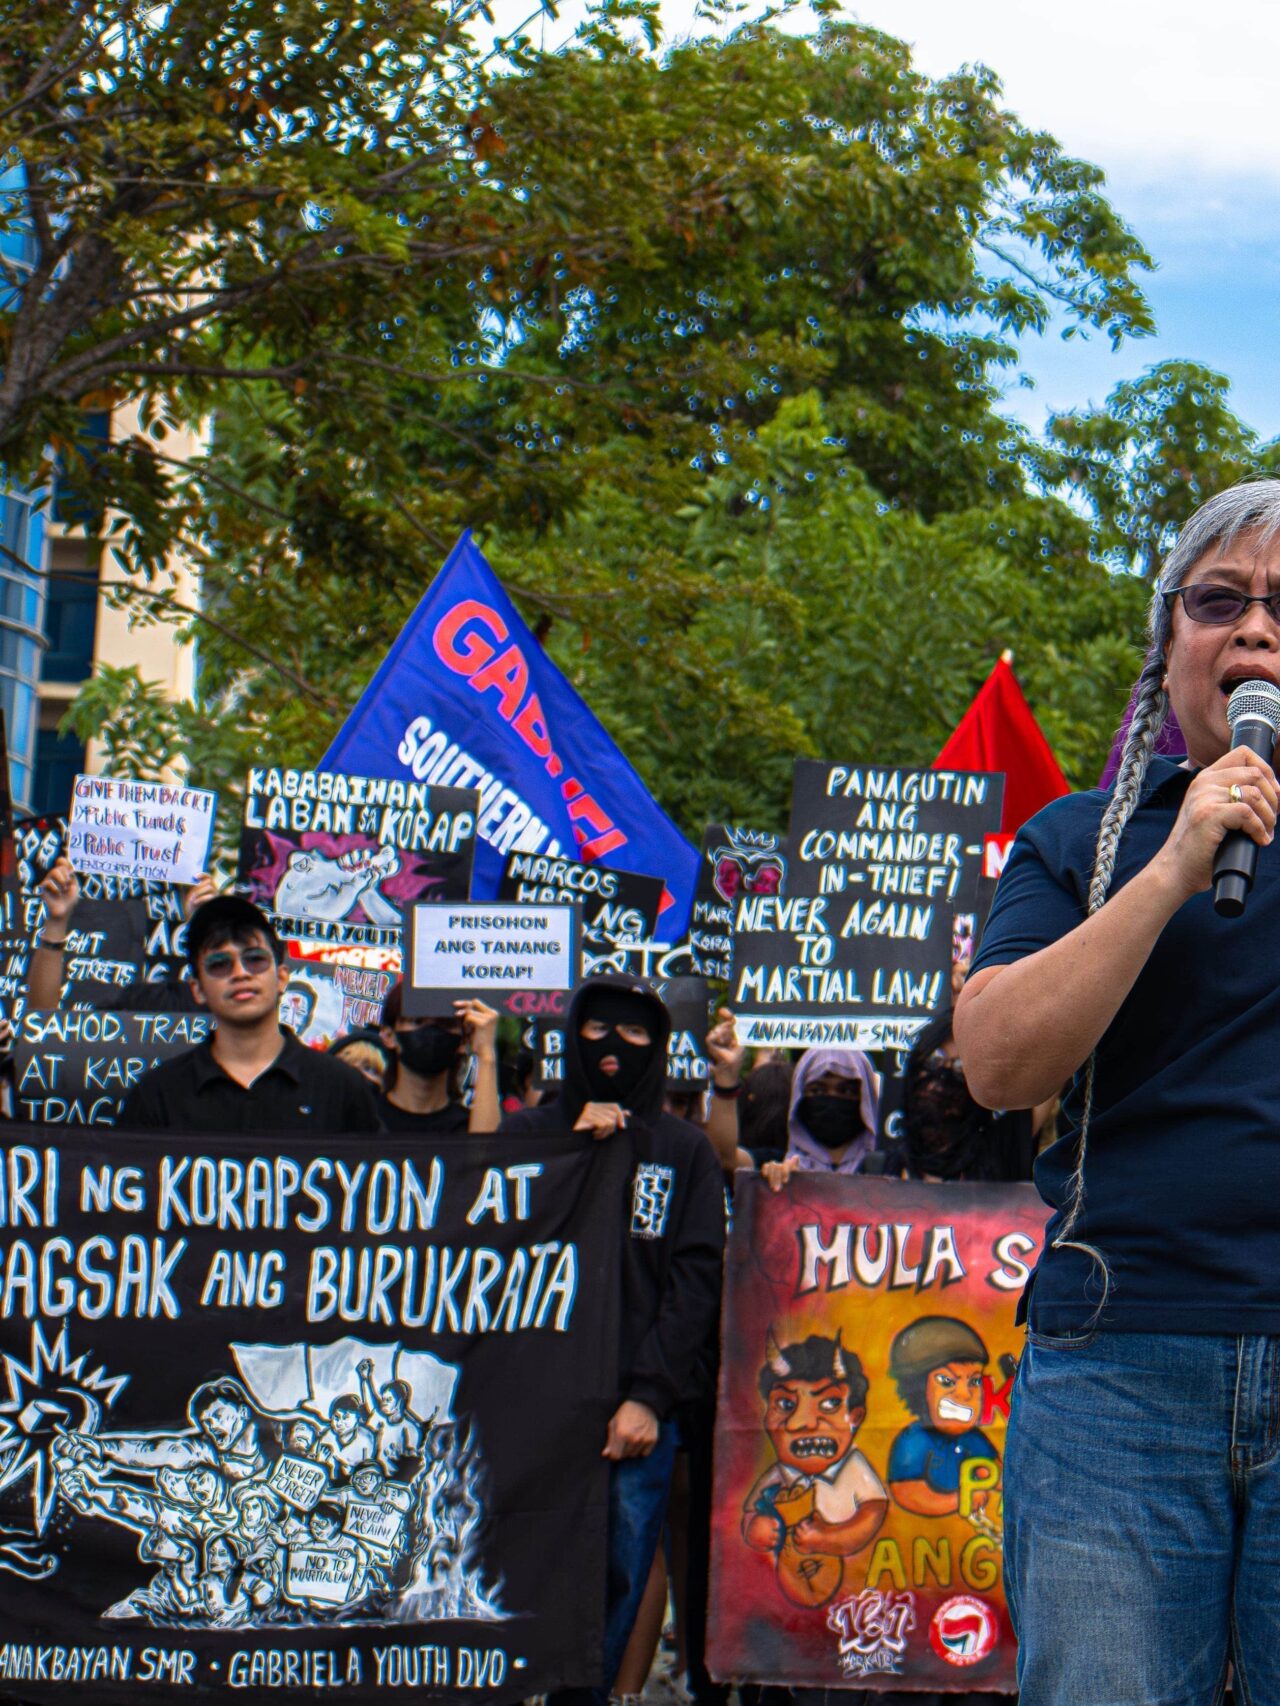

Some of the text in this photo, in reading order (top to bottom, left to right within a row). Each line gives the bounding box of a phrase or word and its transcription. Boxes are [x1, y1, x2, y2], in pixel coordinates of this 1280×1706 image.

[75, 779, 212, 814] GIVE THEM BACK!
[247, 767, 429, 809] KABABAIHAN
[826, 765, 990, 806] PANAGUTIN
[83, 805, 129, 827] Public
[133, 808, 188, 835] Funds
[245, 795, 351, 834] LABAN
[379, 807, 475, 852] KORAP
[856, 799, 920, 832] ANG
[83, 832, 126, 857] Public
[130, 836, 184, 865] Trust
[799, 828, 984, 867] COMMANDER-
[507, 853, 620, 899] MARCOS
[449, 914, 549, 931] PRISOHON
[735, 894, 829, 934] NEVER
[841, 899, 935, 941] AGAIN
[435, 938, 562, 956] ANG TANANG
[794, 932, 836, 966] TO
[462, 962, 535, 980] KORAP!
[735, 964, 945, 1010] MARTIAL LAW!
[133, 1013, 218, 1045] TRAB
[18, 1052, 161, 1092] AT KAR
[80, 1165, 146, 1213] NG
[156, 1154, 445, 1236] KORAPSYON
[465, 1162, 545, 1227] AT
[800, 1222, 1038, 1295] MULA S
[0, 1234, 579, 1335] AGSAK ANG BURUKRATA
[280, 1460, 322, 1488] NEVER
[349, 1505, 387, 1522] NEVER
[305, 1554, 347, 1572] NO TO
[135, 1646, 197, 1685] SMR
[228, 1649, 359, 1688] GABRIELA
[374, 1647, 452, 1687] YOUTH
[455, 1648, 508, 1688] DVO
